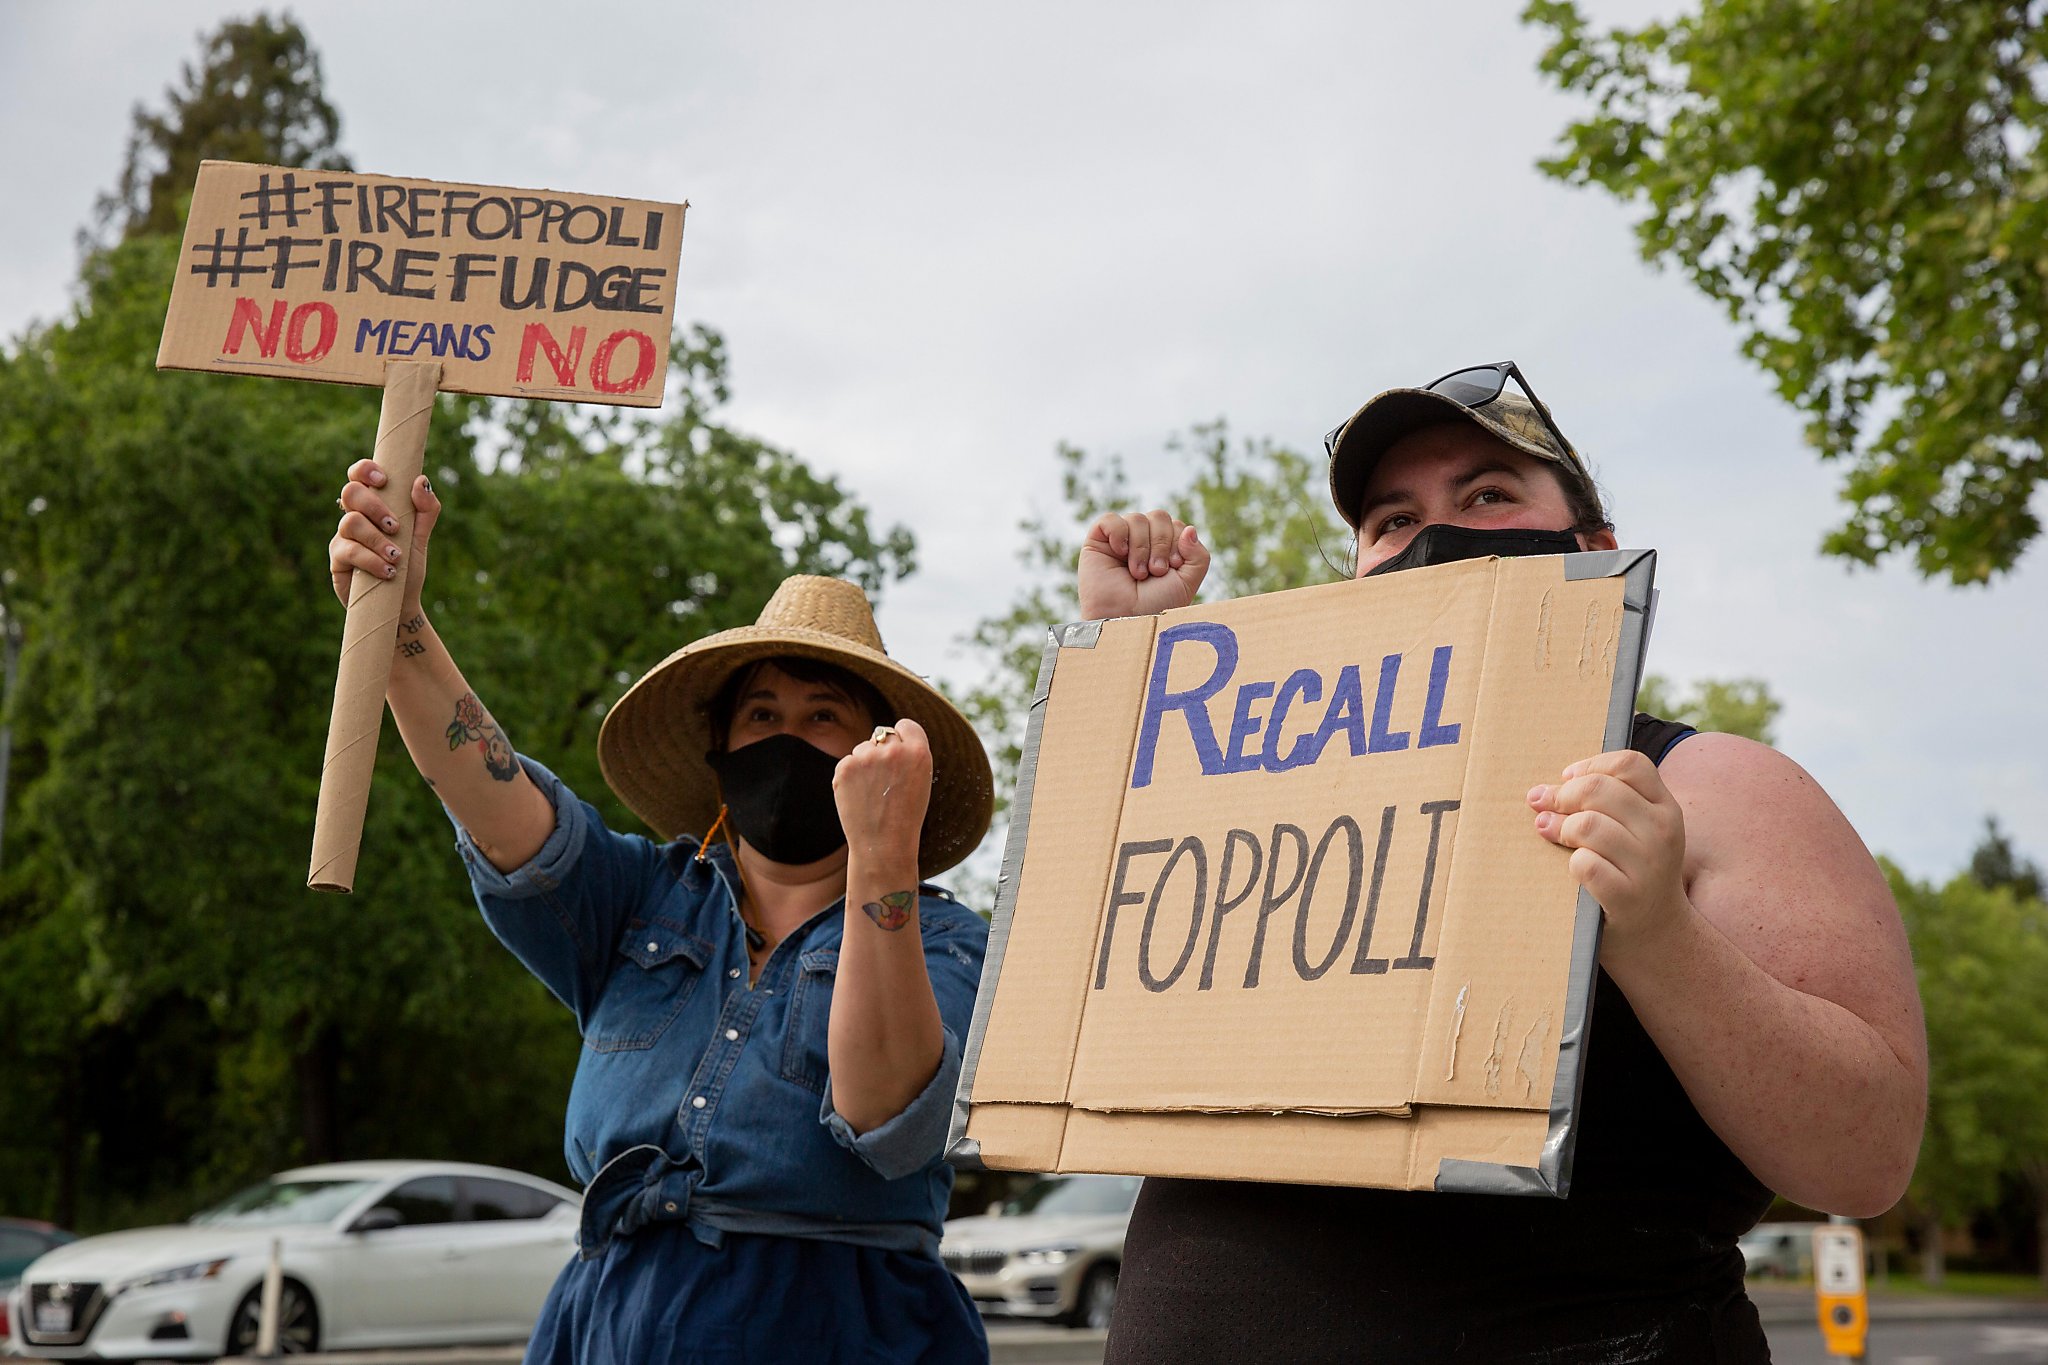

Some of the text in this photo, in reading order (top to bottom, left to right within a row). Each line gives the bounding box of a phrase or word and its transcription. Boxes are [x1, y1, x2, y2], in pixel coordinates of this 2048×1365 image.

[239, 172, 662, 250] #FIREFOPPOLI
[190, 227, 667, 314] #FIREFUDGE
[221, 297, 657, 394] NO MEANS NO
[1131, 621, 1461, 788] RECALL
[1094, 800, 1460, 993] FOPPOLI
